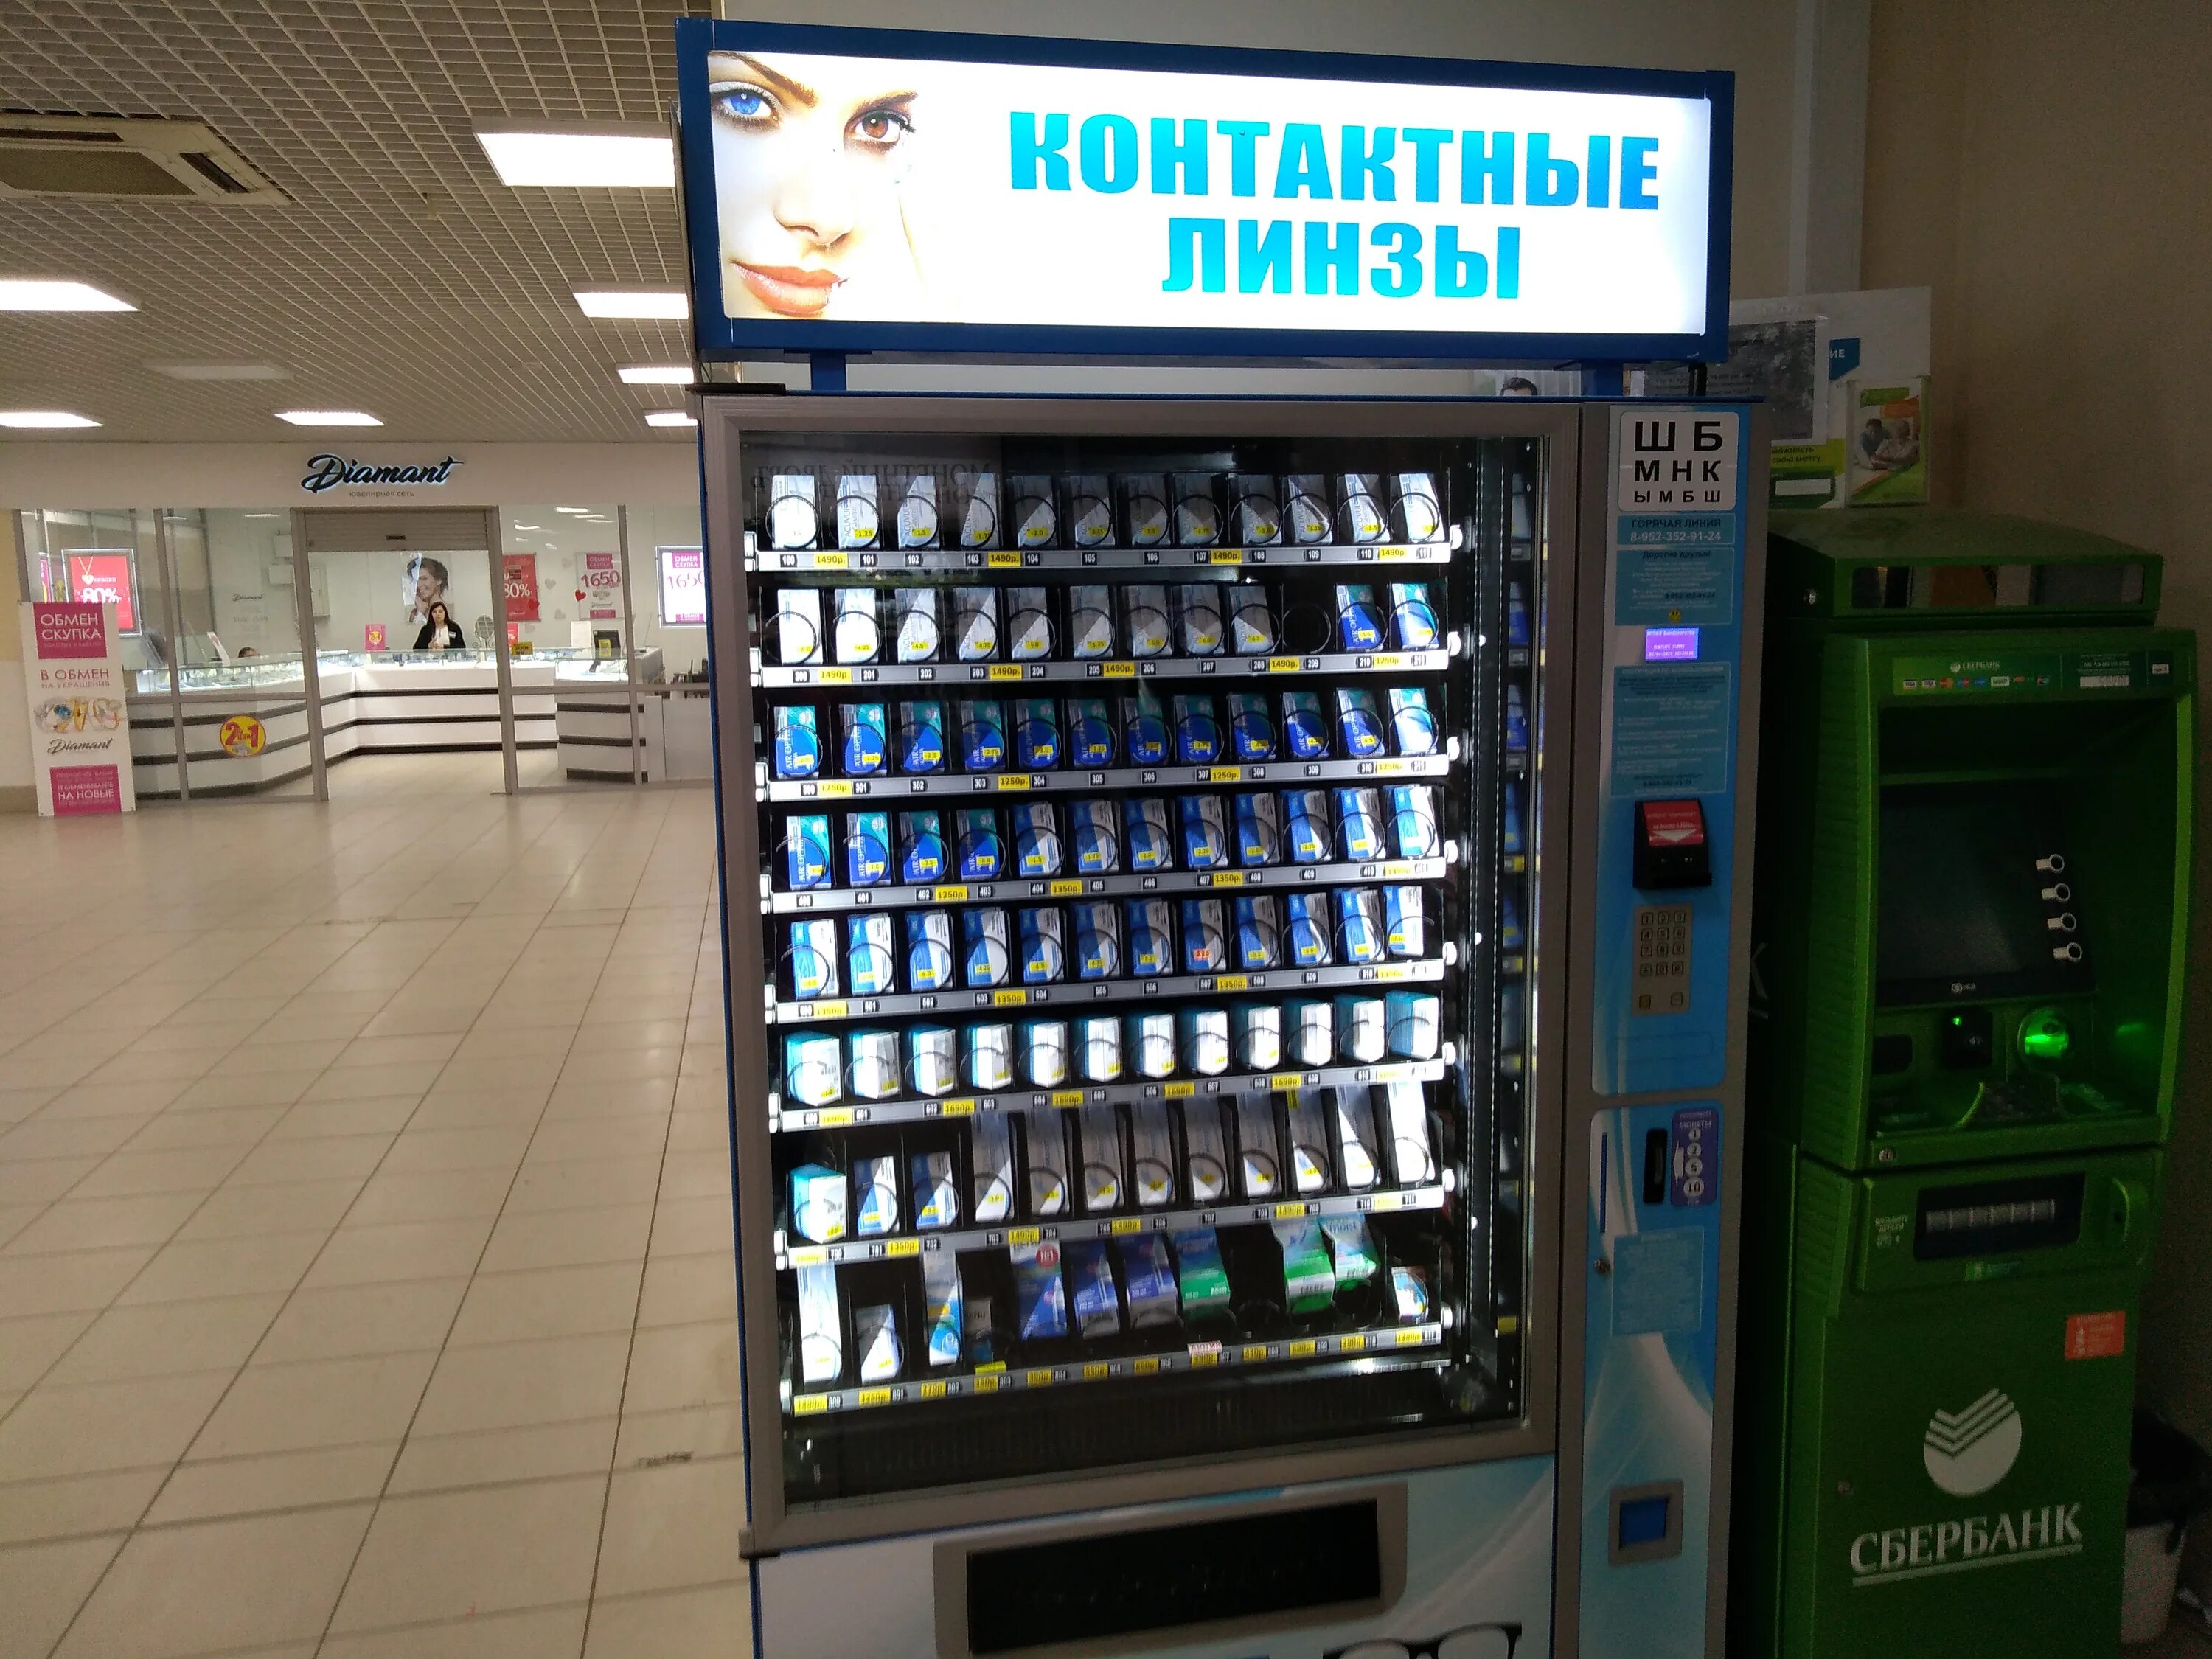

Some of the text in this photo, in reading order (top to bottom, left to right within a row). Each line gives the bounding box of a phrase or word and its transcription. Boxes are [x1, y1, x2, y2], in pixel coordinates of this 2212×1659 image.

[1009, 110, 1660, 211] КОНТАКТНЫЕ
[1161, 216, 1520, 299] ЛИНЗЫ
[1635, 421, 1722, 451] Ш Б
[301, 453, 465, 493] Diamant
[1635, 460, 1721, 481] М Н К
[1634, 490, 1720, 503] Ы М Б Ш
[1632, 518, 1721, 529] ГОРЯЧАЯ ЛИНИЯ
[968, 554, 979, 563] 103
[1027, 554, 1038, 563] 104
[1085, 554, 1095, 563] 105
[1147, 553, 1158, 562] 106
[1196, 552, 1207, 561] 107
[1253, 551, 1265, 560] 108
[1308, 550, 1319, 559] 109
[1361, 550, 1371, 558] 110
[782, 555, 794, 566] 100
[863, 555, 874, 564] 101
[908, 554, 919, 564] 102
[581, 570, 621, 588] 1650
[40, 613, 99, 626] ОБМЕН
[41, 628, 102, 640] СКУПКА
[1253, 661, 1265, 669] 208
[1308, 659, 1318, 668] 209
[1360, 658, 1370, 667] 210
[1032, 667, 1043, 676] 204
[1089, 665, 1099, 675] 205
[1144, 664, 1154, 672] 206
[1203, 663, 1214, 672] 207
[41, 669, 110, 681] В ОБМЕН
[863, 669, 875, 680] 201
[921, 669, 932, 678] 202
[972, 668, 983, 678] 203
[47, 738, 115, 754] Diamant
[1253, 768, 1264, 777] 308
[1308, 766, 1319, 775] 309
[1362, 764, 1372, 773] 310
[1092, 775, 1103, 784] 305
[1144, 773, 1155, 782] 306
[1198, 771, 1208, 780] 307
[975, 779, 986, 788] 303
[1034, 776, 1045, 786] 304
[855, 783, 866, 793] 301
[913, 782, 924, 790] 302
[58, 789, 114, 801] НА НОВЫЕ
[1304, 870, 1314, 879] 409
[1364, 867, 1374, 875] 410
[1200, 876, 1210, 885] 407
[1251, 872, 1261, 881] 408
[1092, 881, 1103, 891] 405
[1144, 879, 1155, 888] 406
[980, 887, 991, 897] 403
[1032, 884, 1043, 894] 404
[858, 893, 869, 902] 401
[919, 890, 929, 900] 402
[1208, 1082, 1218, 1091] 607
[1255, 1079, 1265, 1088] 608
[1094, 1091, 1105, 1100] 605
[1146, 1087, 1157, 1096] 606
[984, 1099, 995, 1109] 603
[1034, 1096, 1046, 1105] 604
[1688, 1183, 1701, 1192] 10
[1851, 1503, 2083, 1574] СБЕРБАНК
